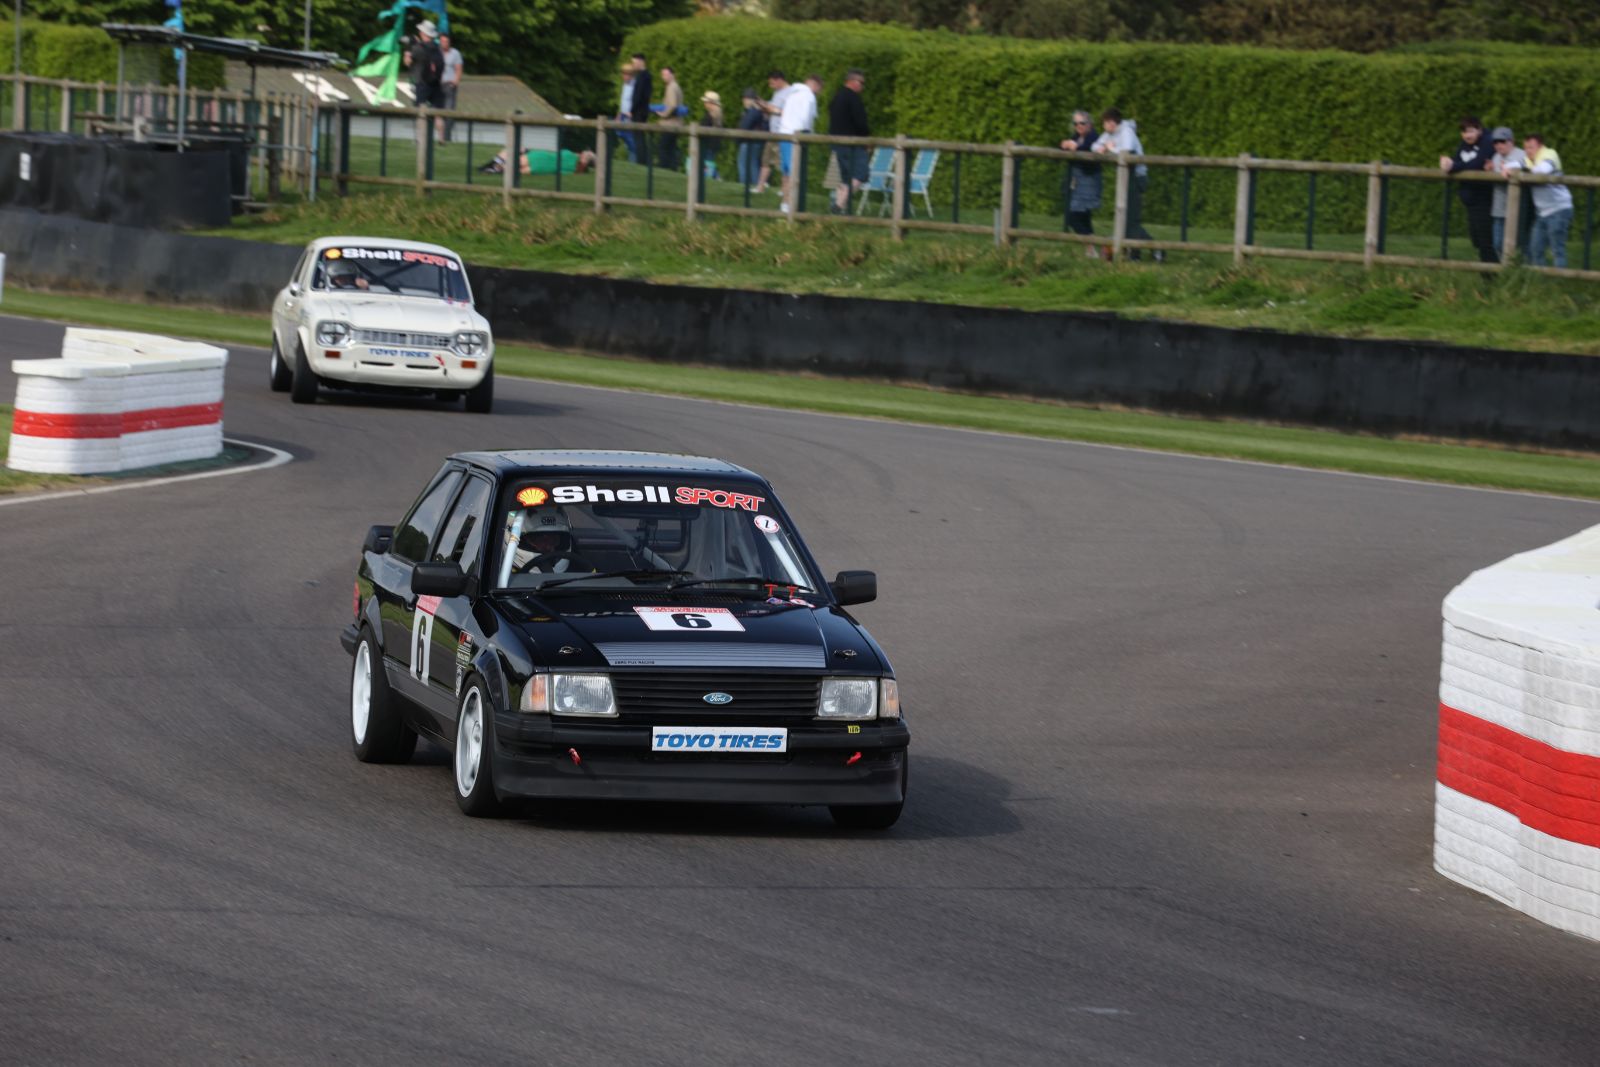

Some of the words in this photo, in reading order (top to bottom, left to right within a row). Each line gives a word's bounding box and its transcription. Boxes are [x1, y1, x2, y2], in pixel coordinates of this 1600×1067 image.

[342, 248, 402, 261] Shell
[402, 251, 449, 267] SPORT
[369, 348, 398, 357] TOYO
[552, 485, 671, 504] Shell
[675, 486, 765, 512] SPORT
[671, 613, 713, 629] 6
[416, 615, 427, 681] 6
[655, 734, 716, 748] TOYO
[718, 735, 785, 749] TIRES
